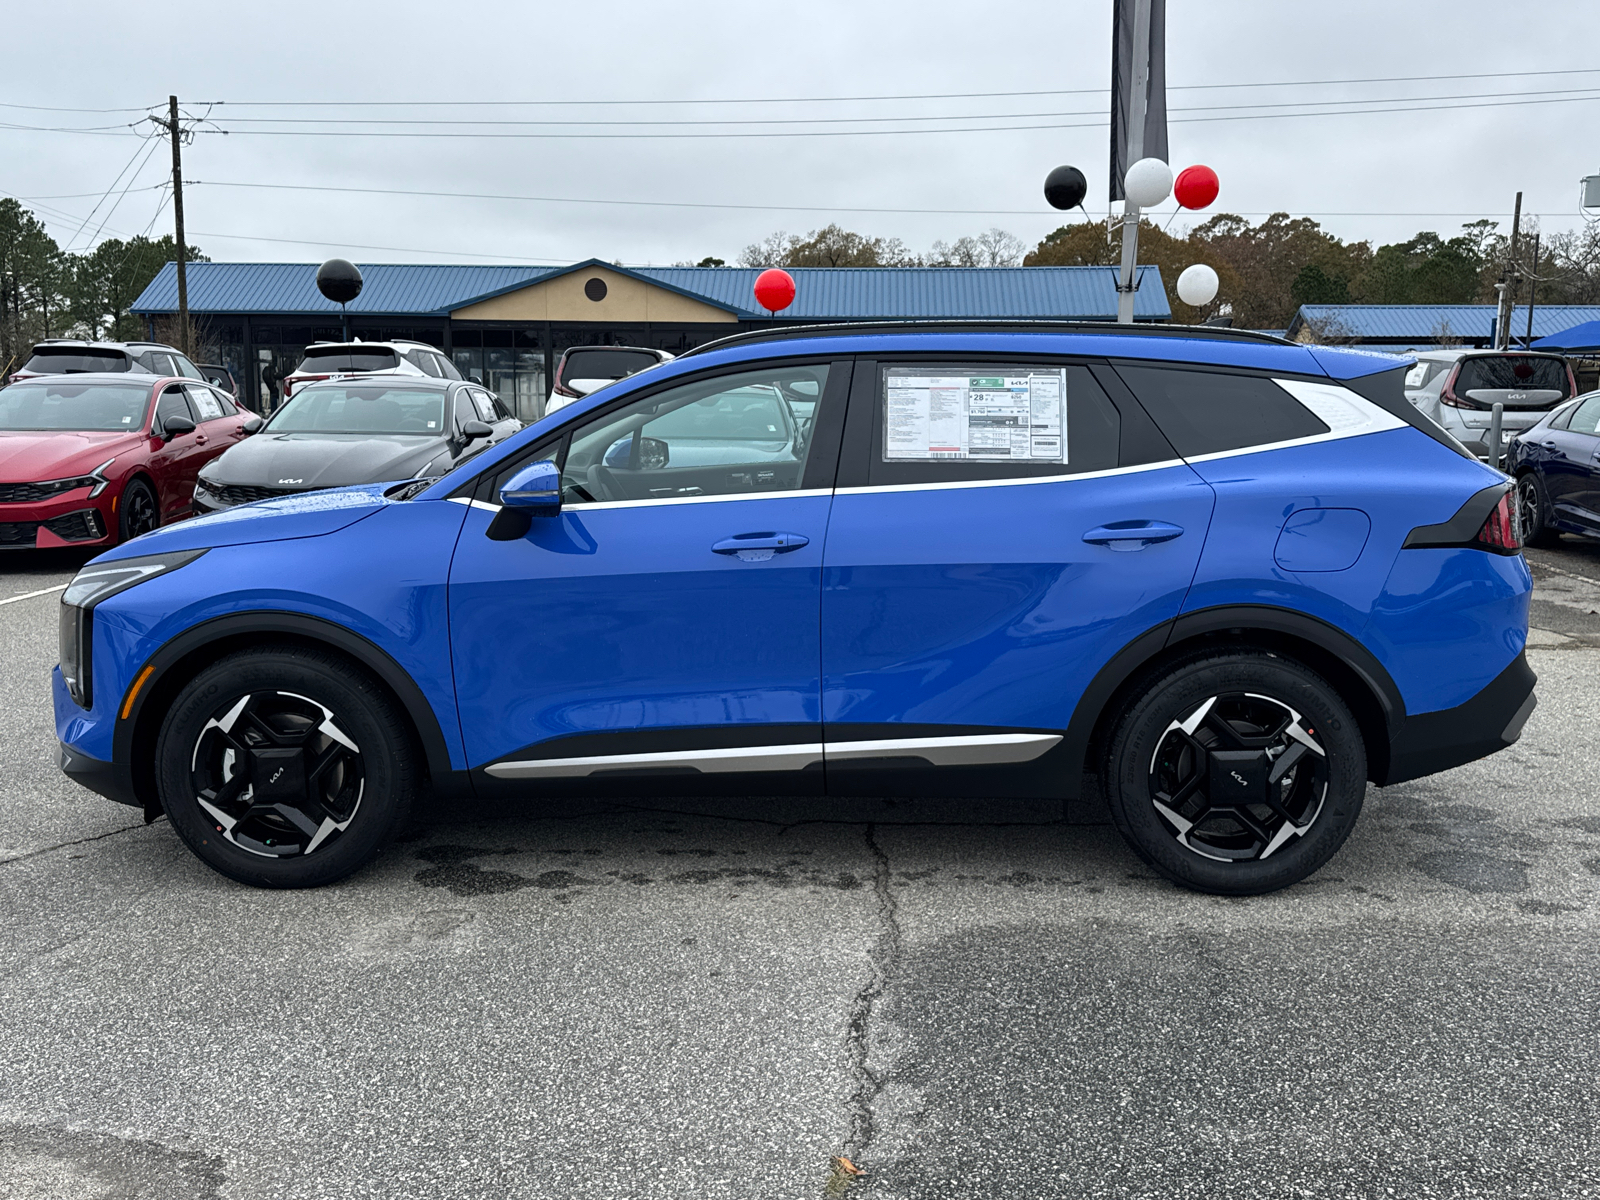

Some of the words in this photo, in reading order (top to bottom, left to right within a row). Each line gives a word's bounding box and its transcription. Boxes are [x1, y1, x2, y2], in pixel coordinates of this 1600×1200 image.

[973, 393, 984, 401] 28
[174, 684, 219, 735] KUMHO
[269, 766, 285, 784] KIA
[1230, 770, 1248, 786] KIA
